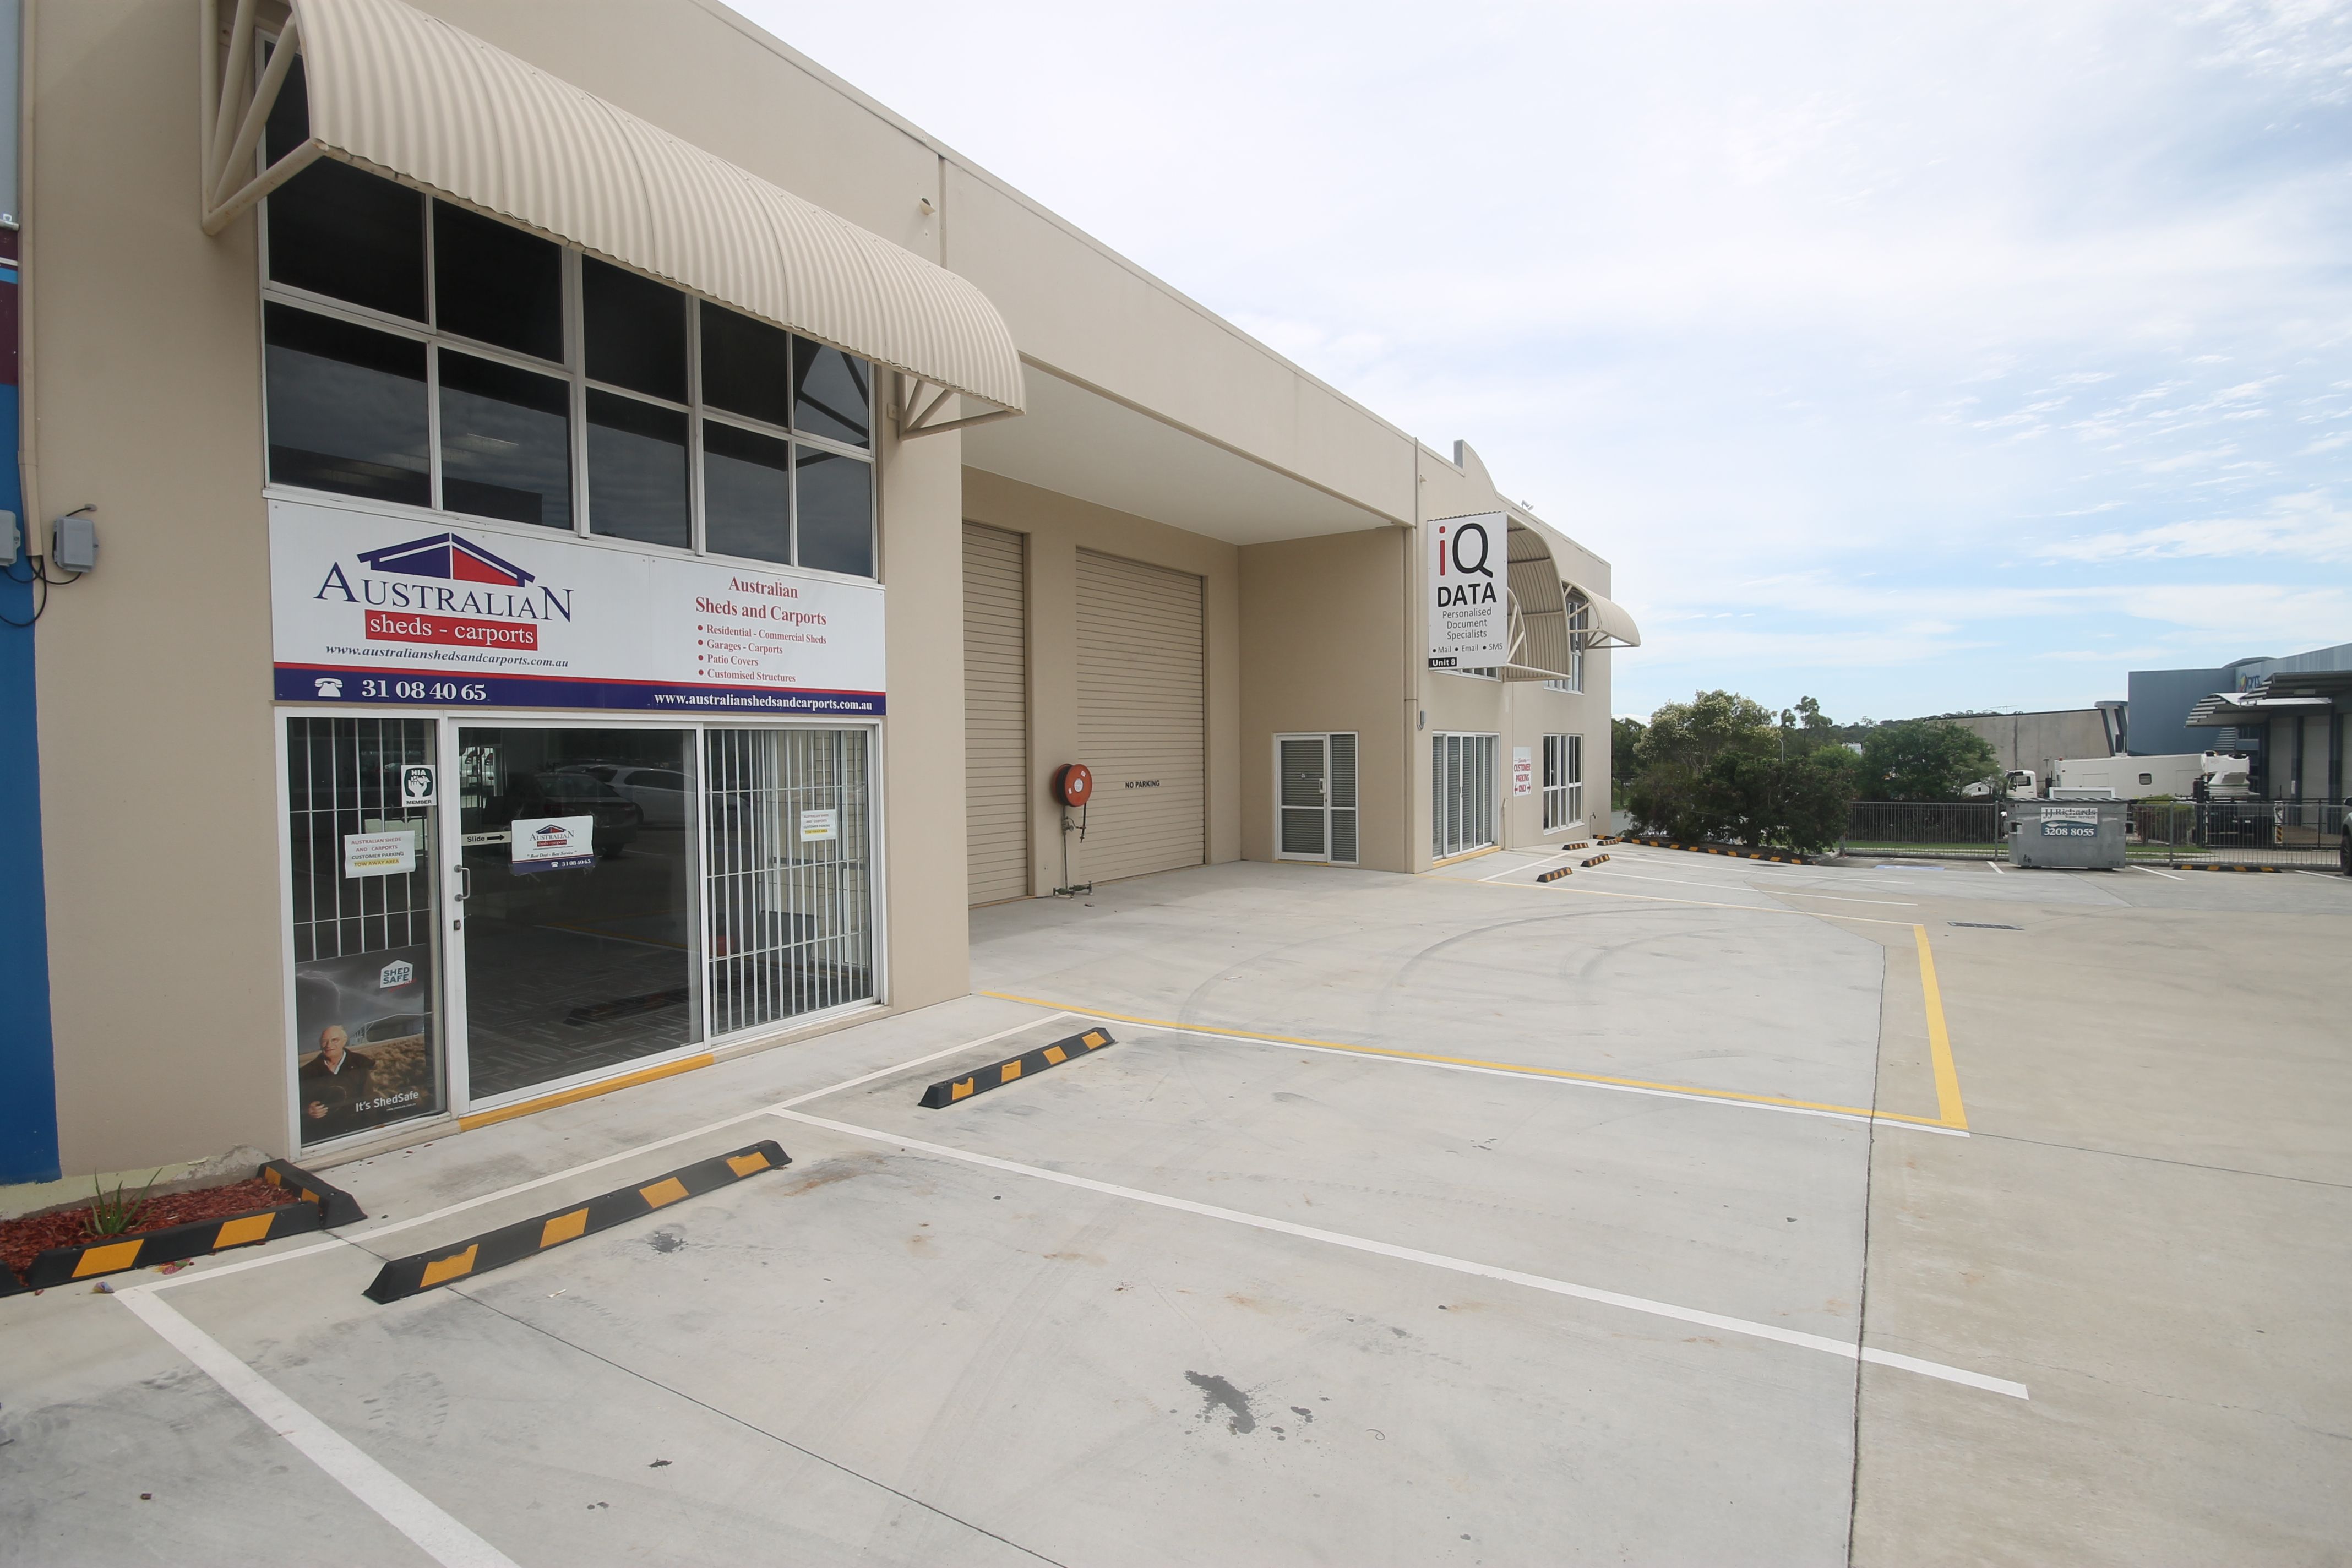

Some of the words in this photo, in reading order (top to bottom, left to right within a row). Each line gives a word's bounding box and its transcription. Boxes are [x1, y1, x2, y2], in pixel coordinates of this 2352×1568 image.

[1439, 522, 1494, 579] iQ
[728, 576, 798, 599] Australian
[1438, 582, 1497, 607] DATA
[695, 596, 738, 616] Sheds
[741, 603, 766, 619] and
[770, 606, 827, 627] Carports
[1442, 607, 1491, 619] Personalised
[370, 614, 432, 637] sheds
[454, 625, 534, 645] carports
[1447, 619, 1487, 629] Document
[706, 624, 752, 638] Residential
[758, 629, 804, 643] Commercial
[805, 634, 827, 644] Sheds
[1447, 629, 1487, 641] Specialists
[706, 639, 741, 652] Garages
[748, 643, 783, 655] Carports
[325, 644, 569, 668] www.australianshedsandcarports.com.au
[707, 654, 728, 665] Patio
[731, 655, 759, 666] Covers
[707, 668, 755, 681] Customised
[756, 671, 796, 683] Structures
[362, 679, 389, 698] 31
[395, 680, 426, 699] 08
[429, 682, 457, 700] 40
[461, 683, 487, 701] 65
[654, 693, 873, 711] www.australianshedsandcarports.com.au
[1135, 780, 1160, 788] PARKING
[1516, 774, 1529, 782] PARKING
[2044, 827, 2068, 836] 3208
[2070, 827, 2094, 836] 8055
[383, 974, 409, 984] SAFE
[384, 967, 410, 977] SHED
[355, 1101, 371, 1112] It's
[373, 1091, 419, 1108] ShedSafe
